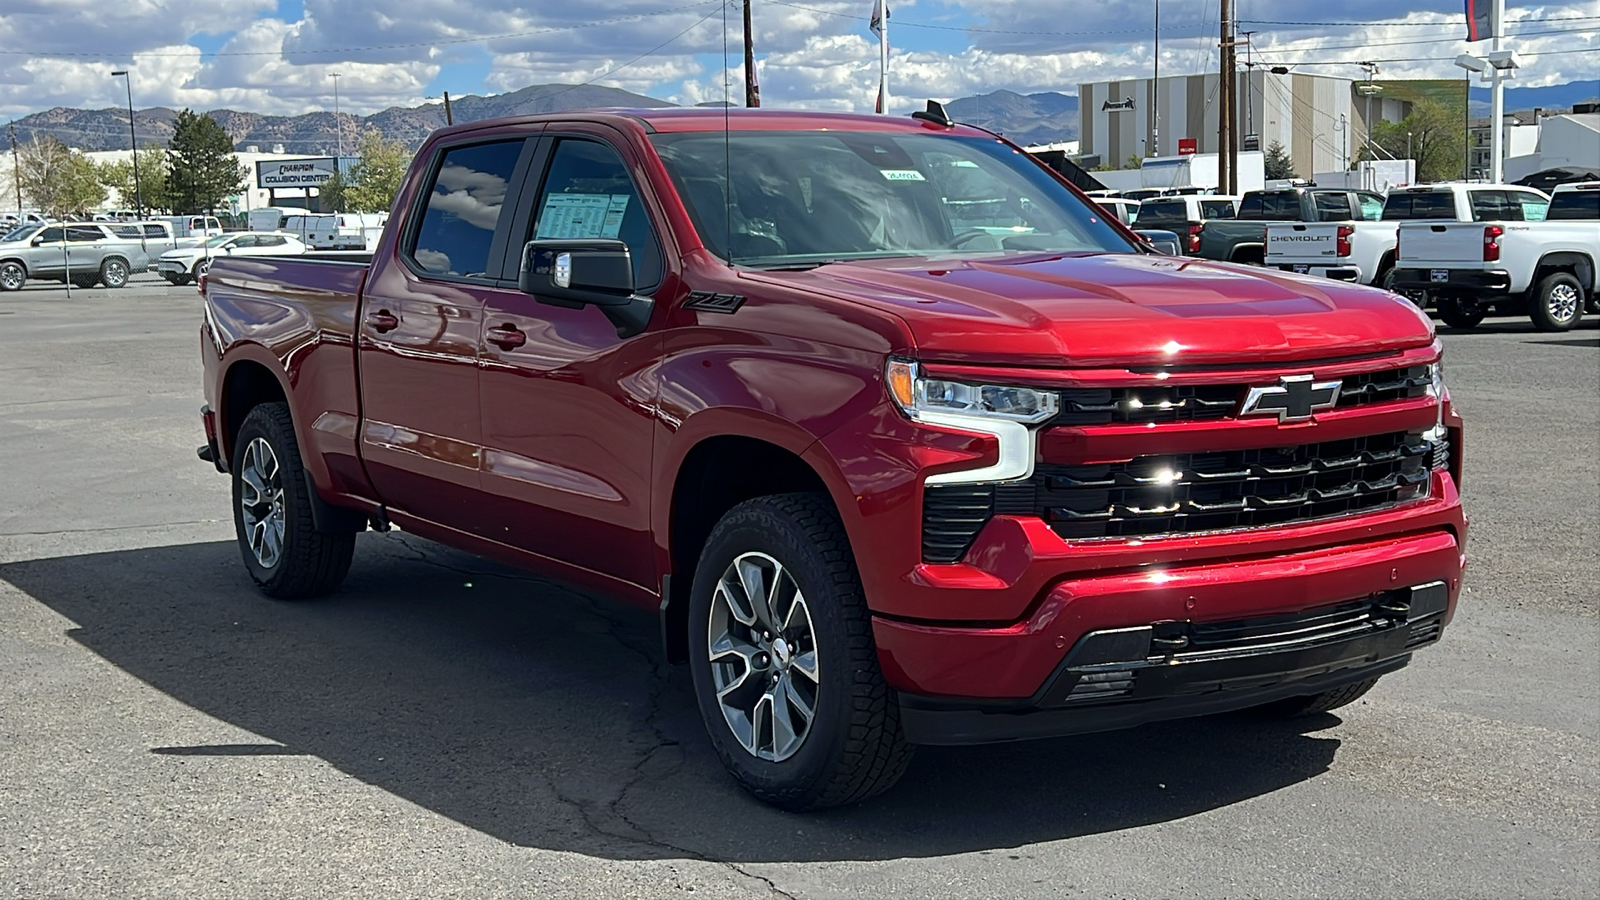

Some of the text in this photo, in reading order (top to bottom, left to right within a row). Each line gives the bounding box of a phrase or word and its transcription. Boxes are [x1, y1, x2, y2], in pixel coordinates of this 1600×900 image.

[279, 164, 314, 175] CHAMPION
[301, 175, 329, 183] CENTER
[680, 290, 747, 314] Z71
